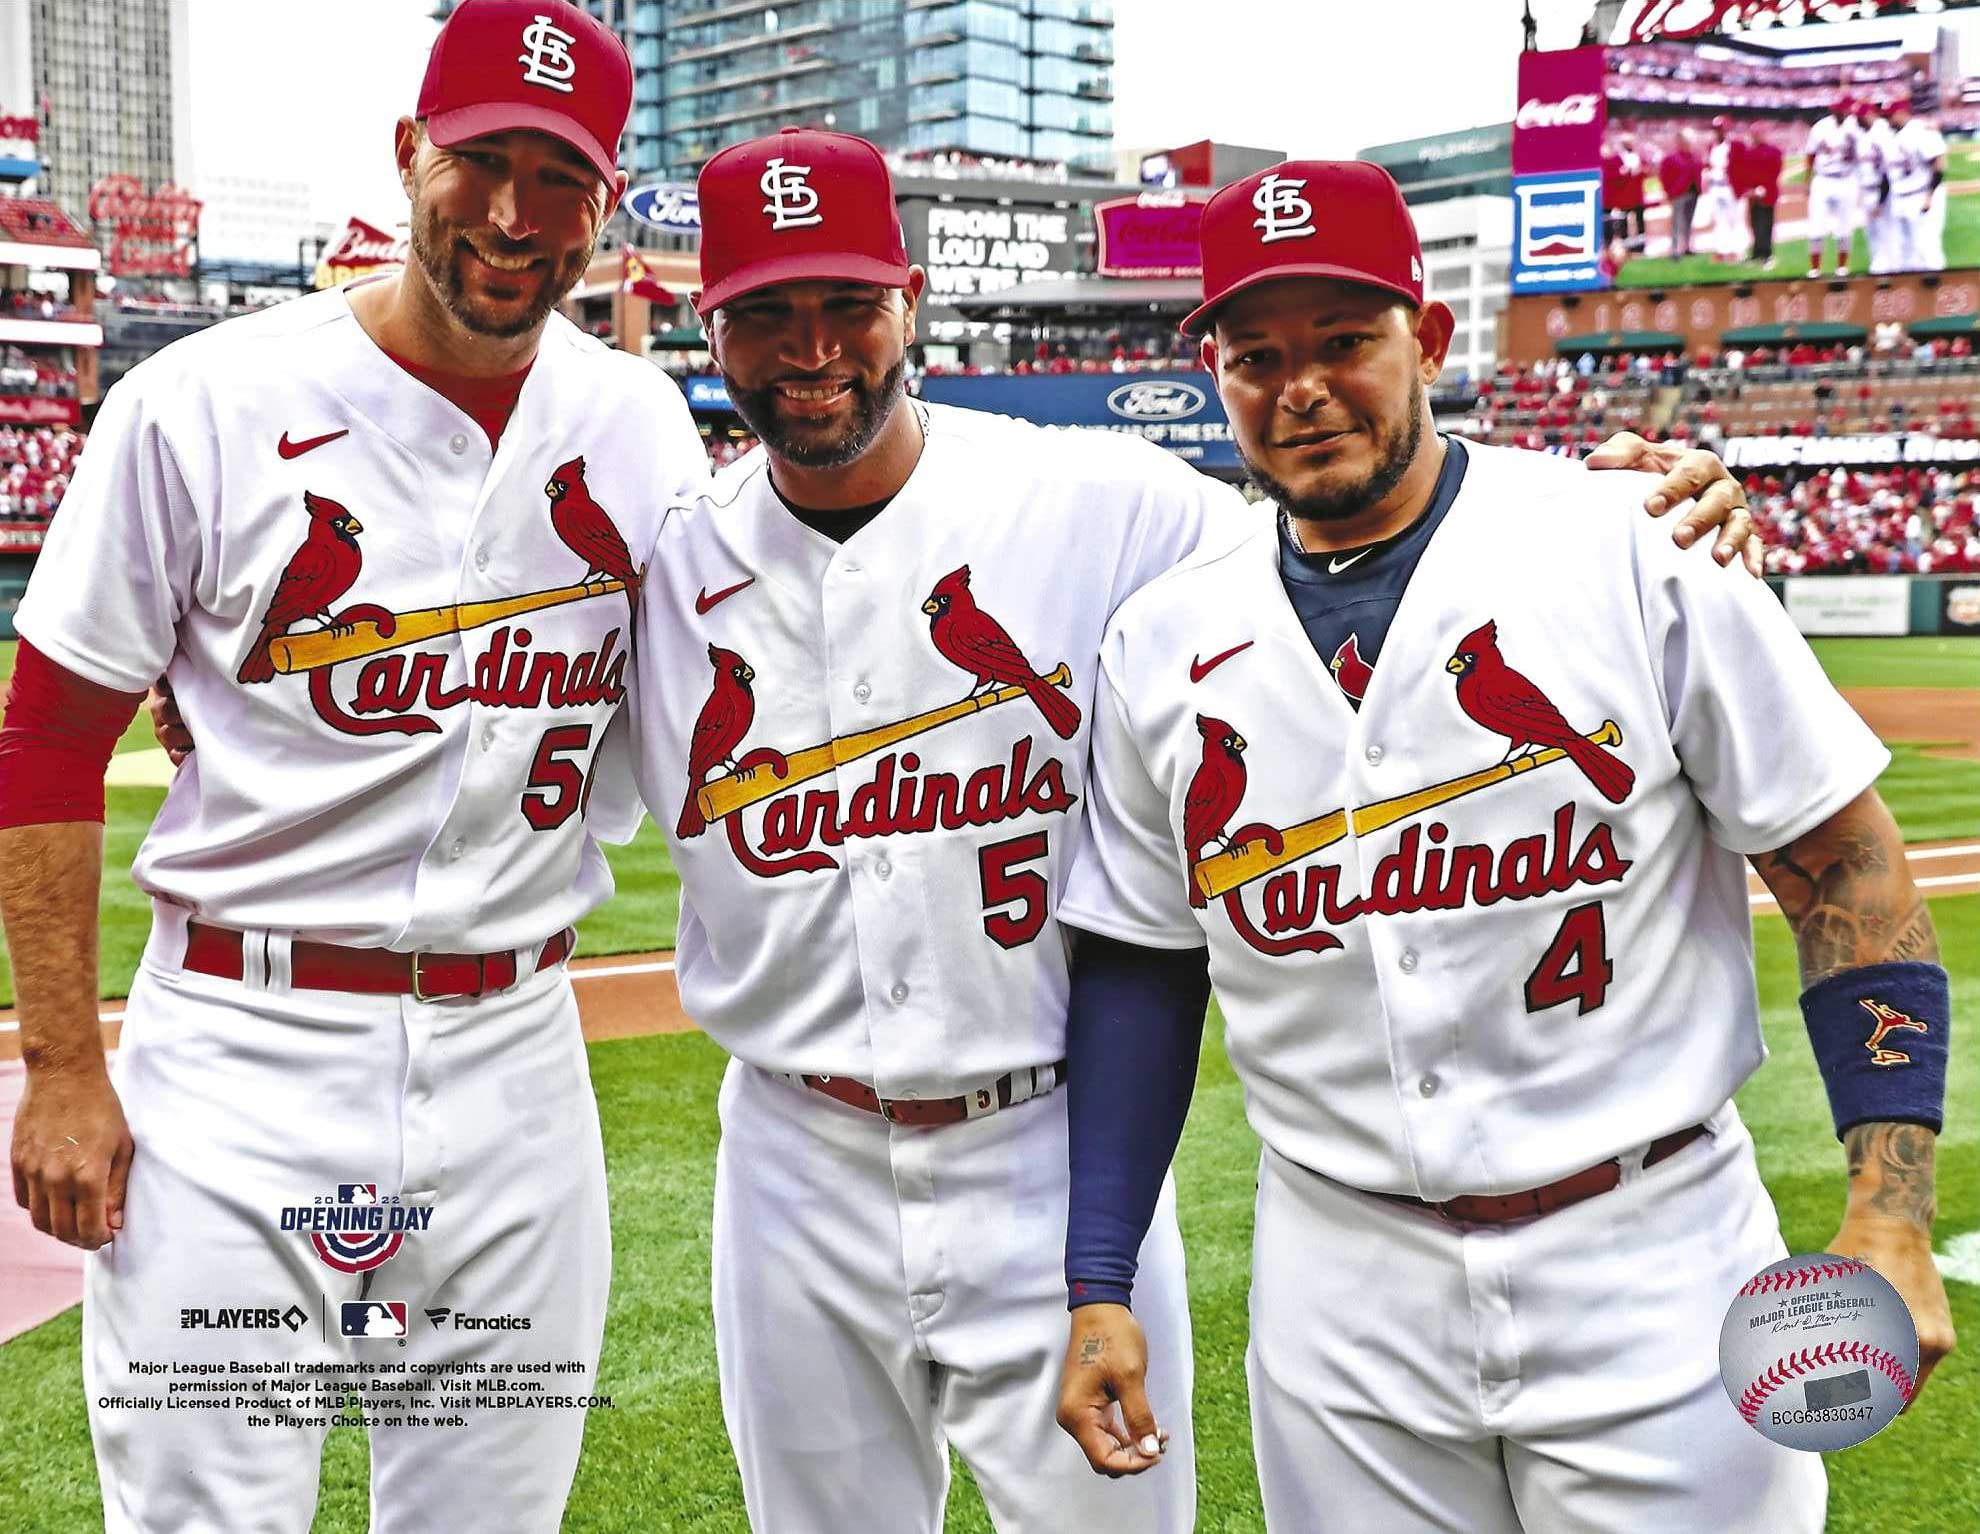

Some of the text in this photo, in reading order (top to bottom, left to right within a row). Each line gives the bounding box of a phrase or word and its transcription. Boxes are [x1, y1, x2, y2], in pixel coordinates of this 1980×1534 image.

[928, 208, 1068, 243] FROM THE
[928, 237, 1050, 269] LOU AND
[308, 604, 628, 736] Cardinals
[521, 724, 602, 832] 5
[725, 735, 1078, 879] Cardinals
[979, 830, 1049, 950] 5
[1222, 801, 1633, 956] Cardinals
[1524, 901, 1613, 1017] 4
